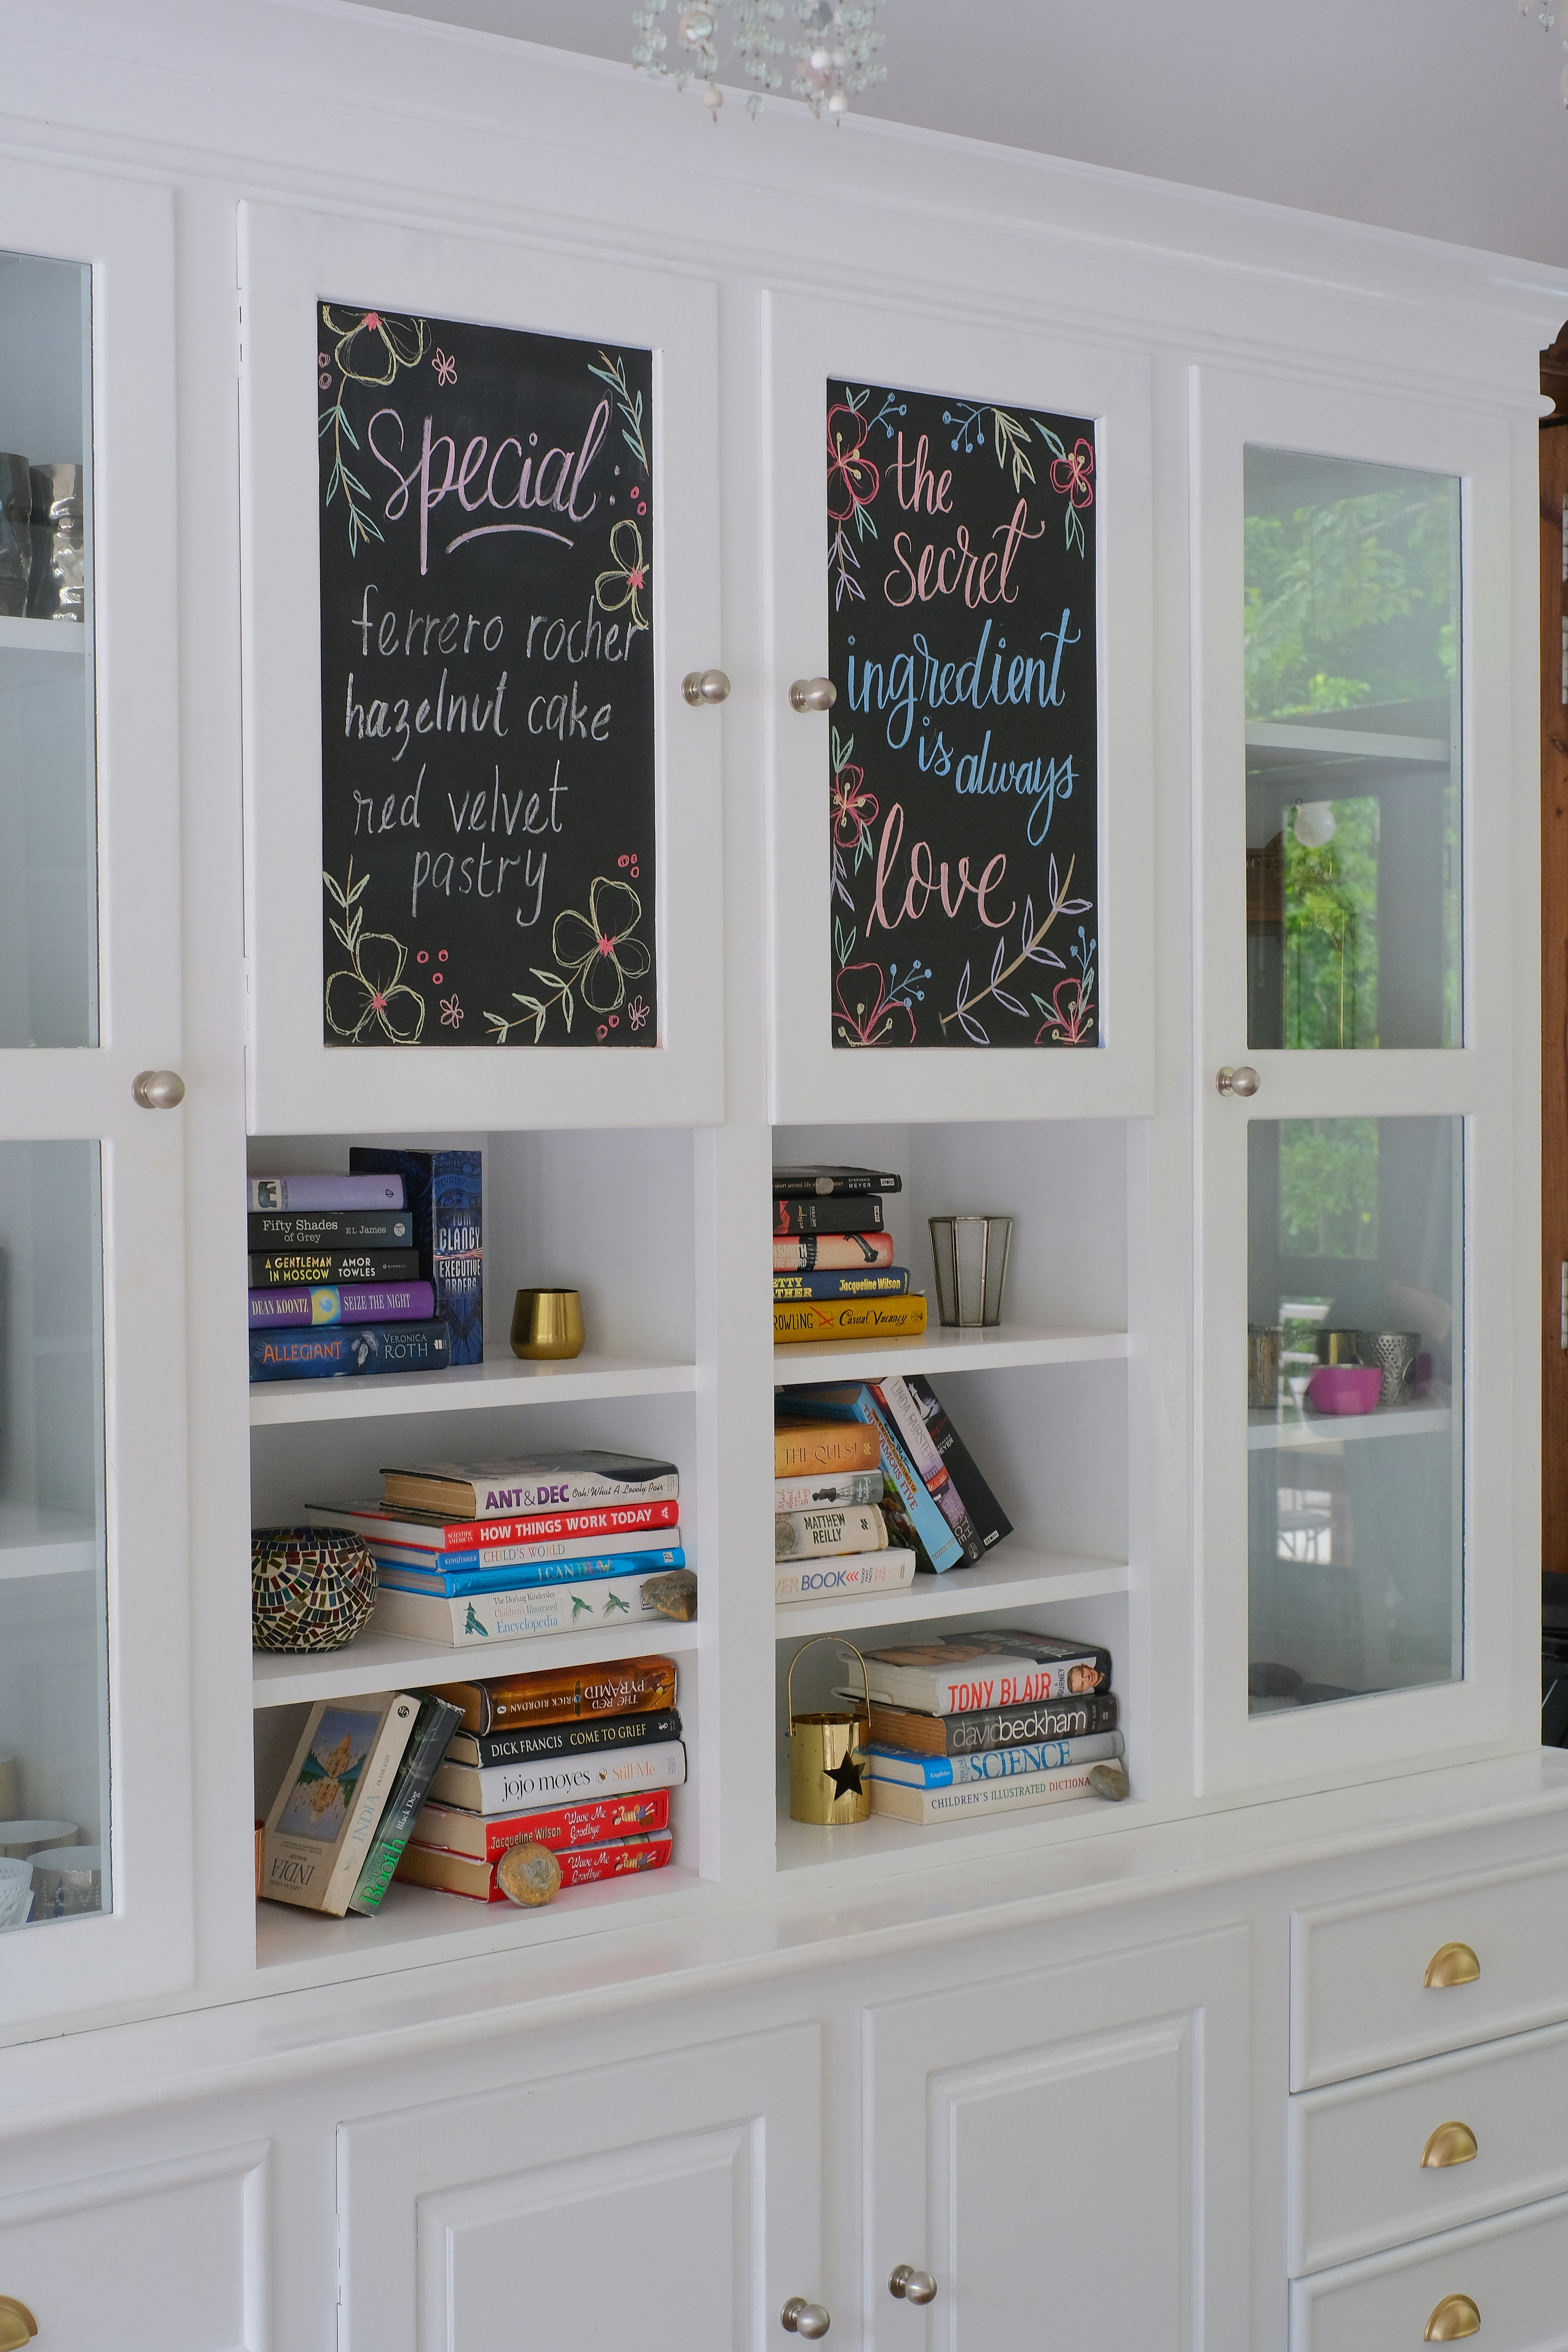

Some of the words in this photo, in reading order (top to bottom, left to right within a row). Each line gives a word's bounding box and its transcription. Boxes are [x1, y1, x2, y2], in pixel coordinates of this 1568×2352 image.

[368, 390, 611, 575] Special
[885, 431, 953, 514] the
[884, 498, 1045, 608] secret
[352, 584, 504, 655] ferrero
[527, 595, 648, 662] rocher
[848, 608, 1081, 749] ingredient
[345, 668, 508, 762] hazelnut
[528, 681, 611, 741] cake
[919, 717, 953, 776] is
[956, 730, 1079, 846] always
[352, 763, 426, 835] red
[448, 759, 568, 835] velvet
[866, 802, 1016, 937] love
[412, 842, 547, 926] pastry
[263, 1220, 292, 1233] Fifty
[296, 1219, 338, 1231] Shades
[453, 1211, 471, 1226] TOM
[798, 1205, 807, 1229] eclipse
[284, 1233, 294, 1242] of
[297, 1233, 321, 1243] Grey
[359, 1225, 386, 1234] James
[439, 1227, 480, 1251] CLANCY
[265, 1258, 271, 1269] A
[274, 1256, 332, 1269] GENTLEMAN
[338, 1268, 375, 1277] TOWLES
[342, 1257, 371, 1267] AMOR
[439, 1259, 480, 1277] EXECUTIVE
[787, 1259, 807, 1268] SWORD
[269, 1269, 279, 1282] IN
[283, 1269, 329, 1281] MOSCOW
[445, 1277, 476, 1295] ORDERS
[773, 1277, 803, 1288] ETTY
[839, 1278, 876, 1294] Jacqueline
[877, 1278, 901, 1290] Wilson
[251, 1300, 274, 1315] DEAN
[276, 1298, 308, 1314] KOONTZ
[343, 1295, 367, 1311] SEIZE
[369, 1295, 385, 1309] THE
[387, 1293, 410, 1308] NIGHT
[839, 1309, 870, 1326] Casual
[870, 1311, 908, 1326] Vacancy
[383, 1334, 427, 1343] VERONICA
[262, 1341, 342, 1364] ALLEGIANT
[385, 1343, 428, 1359] ROTH
[891, 1380, 911, 1416] LINDA
[906, 1413, 935, 1466] FAIRSTEIN
[782, 1447, 810, 1464] THE
[814, 1443, 858, 1465] QUEST
[896, 1444, 910, 1473] Blyton
[892, 1446, 913, 1485] ADVENTURES
[910, 1482, 917, 1493] OF
[572, 1488, 590, 1498] Ooh!
[591, 1487, 611, 1496] What
[614, 1485, 621, 1494] A
[623, 1483, 646, 1496] Lovely
[648, 1482, 663, 1493] Pair
[777, 1489, 785, 1510] Mad
[801, 1488, 810, 1506] Boy
[900, 1480, 918, 1510] FIVE
[481, 1525, 511, 1541] HOW
[515, 1519, 562, 1536] THINGS
[566, 1514, 607, 1530] WORK
[611, 1509, 652, 1525] TODAY
[804, 1513, 845, 1530] MATTHEW
[941, 1499, 967, 1545] DANCE
[950, 1493, 973, 1537] DEATH
[813, 1528, 841, 1544] REILLY
[484, 1548, 525, 1563] CHILD'S
[528, 1544, 565, 1557] WORLD
[538, 1568, 542, 1582] I
[545, 1564, 574, 1580] CAN
[577, 1559, 614, 1577] DRAW
[801, 1570, 847, 1591] BOOK
[505, 1595, 527, 1604] Dorling
[527, 1591, 555, 1602] Kindersley
[495, 1605, 525, 1618] Children's
[527, 1602, 557, 1614] Illustrated
[497, 1614, 558, 1634] Encyclopedia
[585, 1677, 645, 1700] PYRAMID
[948, 1680, 994, 1713] TONY
[999, 1672, 1051, 1706] BLAIR
[510, 1698, 549, 1712] RIORDAN
[552, 1697, 571, 1706] RICK
[593, 1698, 613, 1709] RED
[617, 1694, 638, 1707] THE
[491, 1741, 519, 1757] DICK
[520, 1735, 563, 1753] FRANCIS
[570, 1731, 599, 1746] COME
[601, 1728, 616, 1740] TO
[618, 1723, 646, 1739] GRIEF
[970, 1741, 1072, 1781] SCIENCE
[502, 1774, 534, 1802] jojo
[538, 1770, 590, 1793] moyes
[612, 1764, 633, 1781] Still
[636, 1761, 655, 1776] Me
[931, 1792, 989, 1810] CHILDREN'S
[991, 1784, 1046, 1801] ILLUSTRATED
[1049, 1775, 1092, 1791] DICTIONA
[352, 1795, 380, 1842] INDIA
[396, 1809, 410, 1830] Black
[406, 1790, 421, 1808] Dog
[564, 1811, 589, 1825] Wave
[591, 1805, 606, 1821] Me
[490, 1832, 533, 1850] Jacqueline
[534, 1827, 561, 1841] Wilson
[570, 1824, 600, 1844] Goodbye
[365, 1856, 382, 1885] Stephen
[568, 1856, 592, 1869] Wave
[594, 1851, 610, 1865] Me
[271, 1858, 315, 1885] INDIA
[360, 1838, 406, 1907] Booth
[572, 1870, 602, 1884] Goodbye
